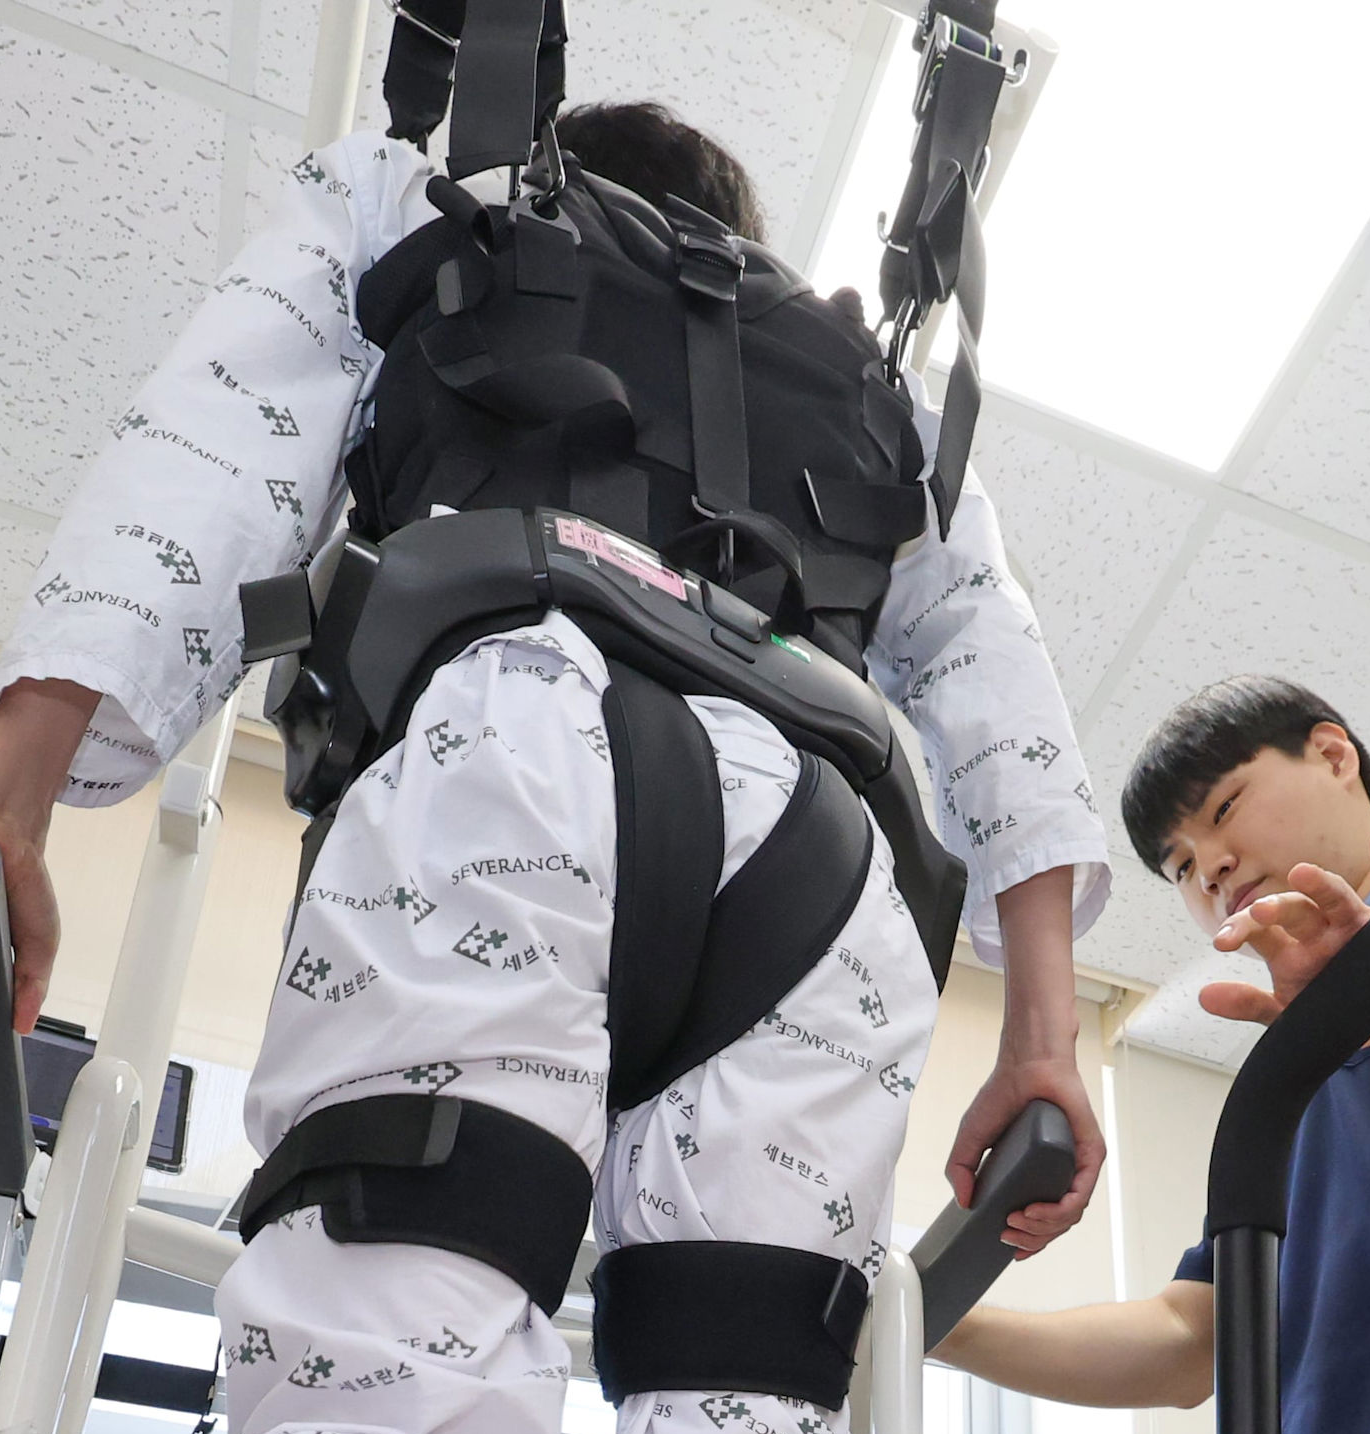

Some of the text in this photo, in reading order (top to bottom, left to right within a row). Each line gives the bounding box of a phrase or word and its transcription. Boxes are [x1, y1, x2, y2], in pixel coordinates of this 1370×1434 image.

[141, 428, 243, 479] SEVERANCE
[113, 524, 184, 555] 세브란스
[949, 737, 1020, 784] SEVERANCE
[451, 853, 575, 886] SEVERANCE
[323, 963, 381, 1004] 세브란스
[776, 1020, 874, 1074] SEVERANCE
[762, 1142, 830, 1188] 세브란스
[337, 1360, 416, 1393] 세브란스
